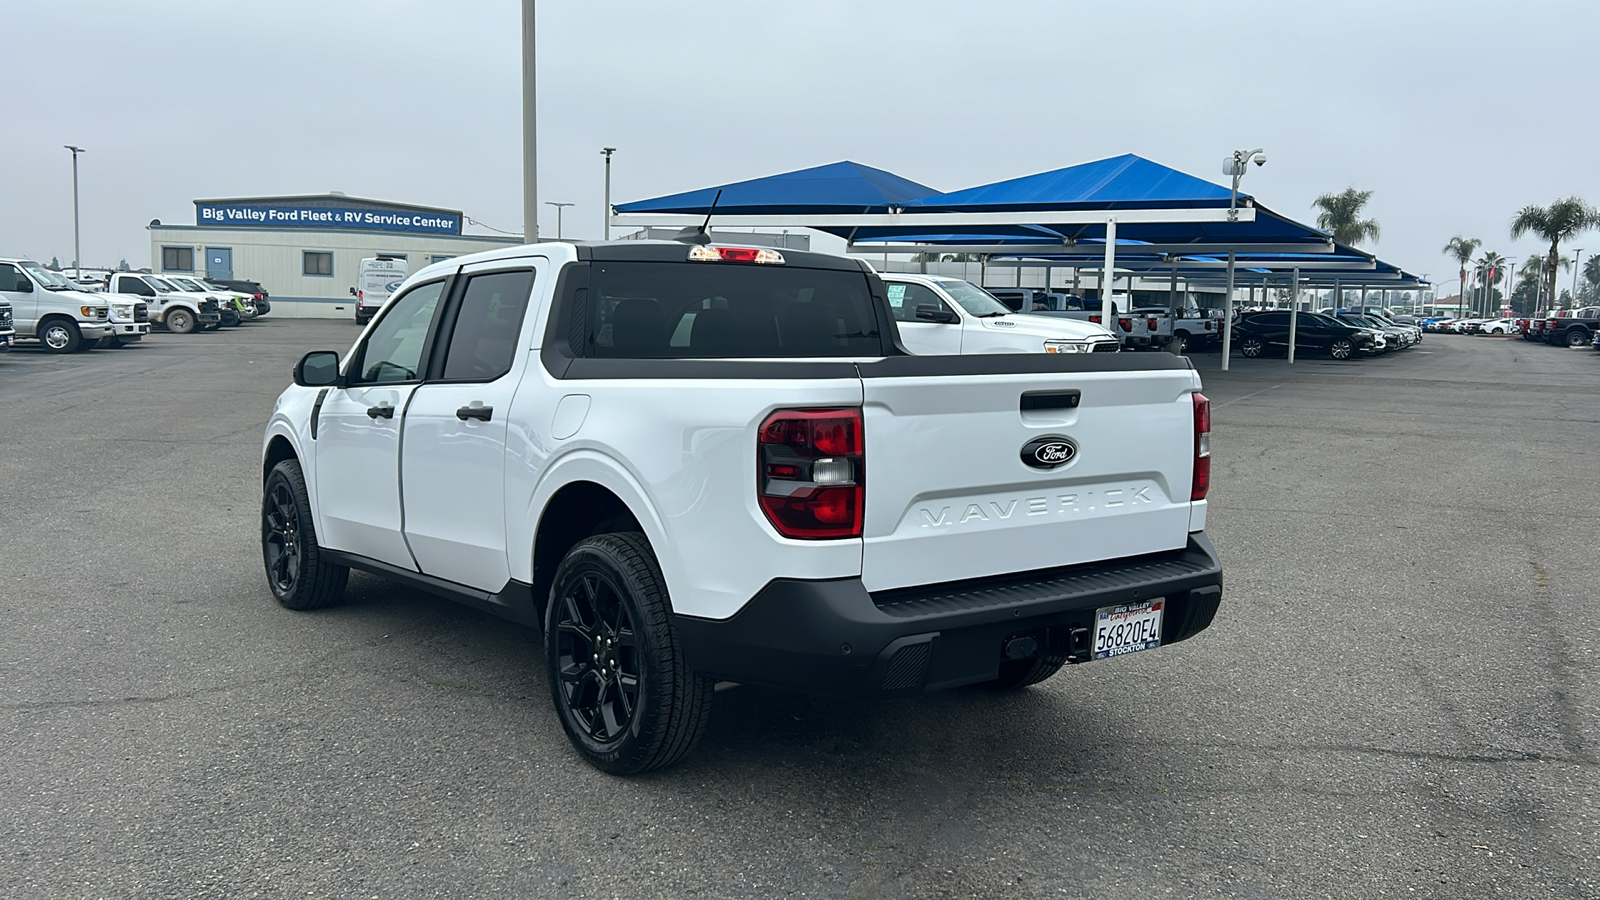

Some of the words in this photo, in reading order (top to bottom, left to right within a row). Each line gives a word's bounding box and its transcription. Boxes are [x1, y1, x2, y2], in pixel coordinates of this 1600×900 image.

[202, 208, 224, 221] Big
[226, 208, 266, 221] Valley
[269, 210, 298, 220] Ford
[300, 210, 332, 221] Fleet
[334, 213, 342, 222] &
[344, 211, 362, 223] RV
[364, 212, 410, 226] Service
[412, 216, 454, 228] Center
[1043, 445, 1068, 460] Ford
[920, 486, 1152, 528] MAVERICK
[1114, 606, 1127, 614] BIG
[1128, 602, 1151, 610] VALLEY
[1097, 617, 1157, 651] 56820E4
[1108, 643, 1146, 657] STOCKTON
